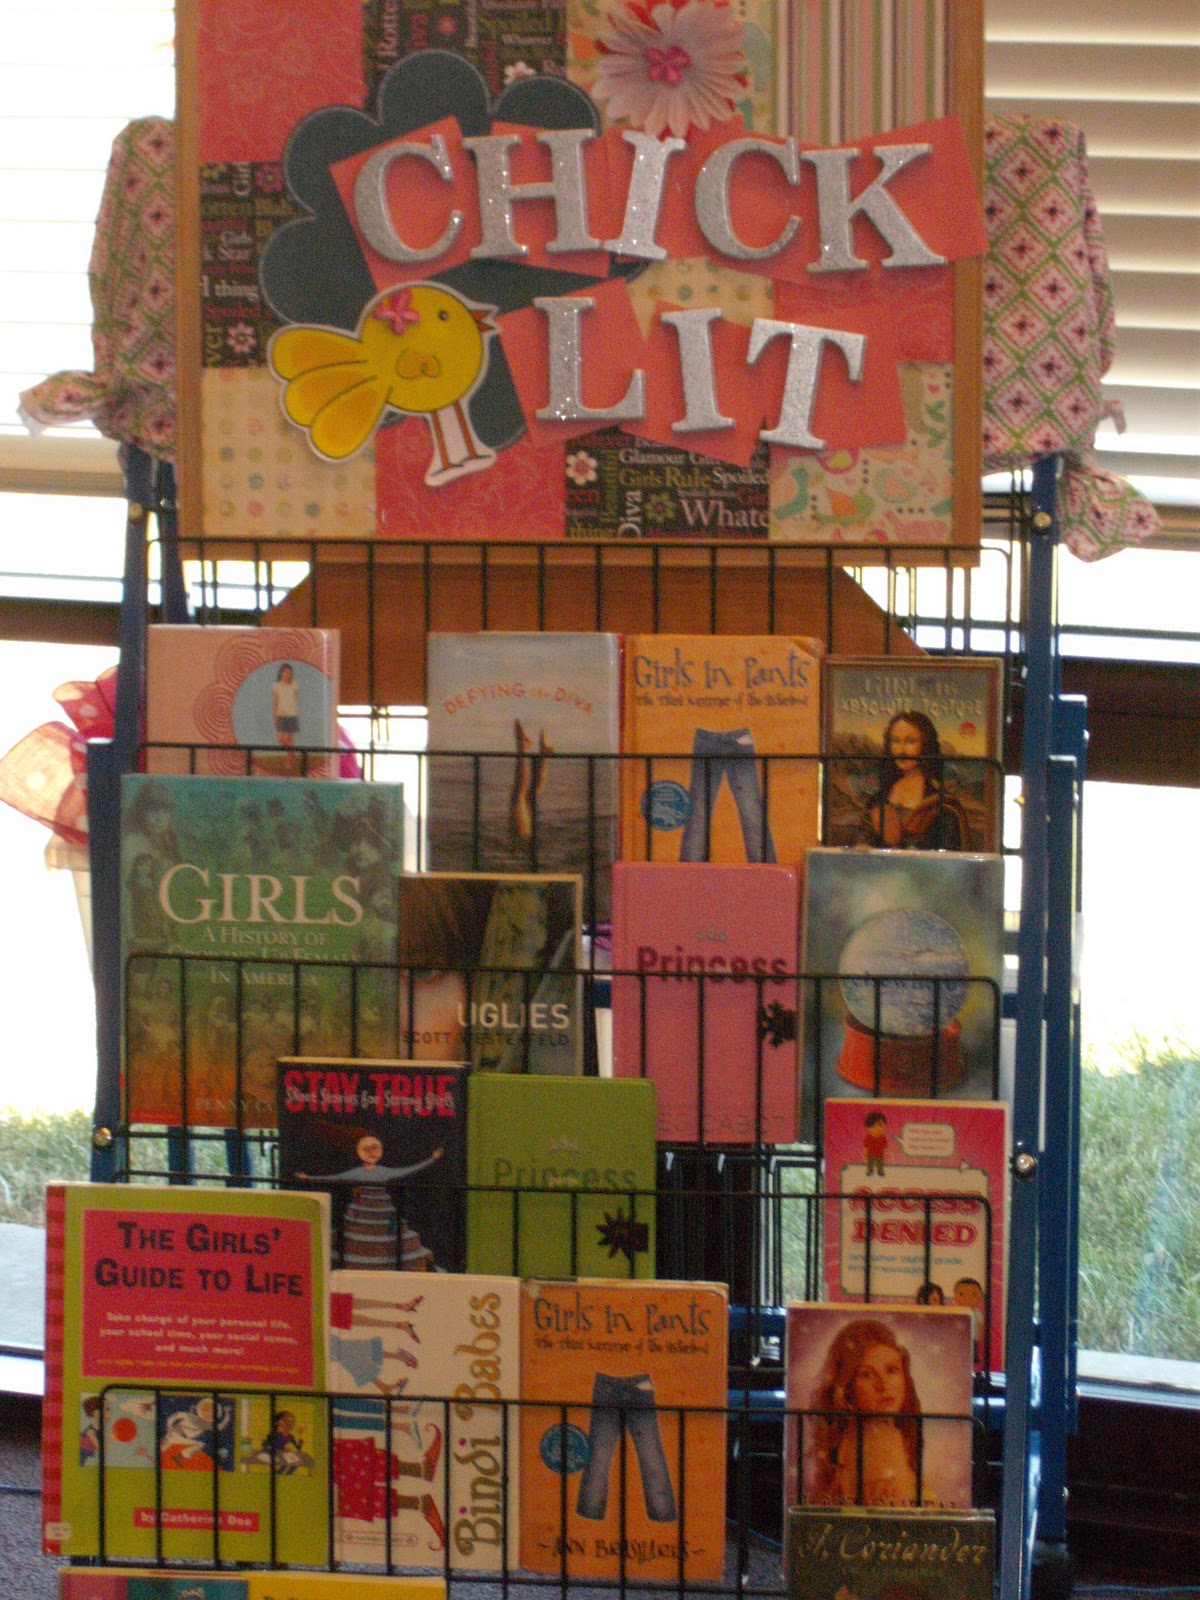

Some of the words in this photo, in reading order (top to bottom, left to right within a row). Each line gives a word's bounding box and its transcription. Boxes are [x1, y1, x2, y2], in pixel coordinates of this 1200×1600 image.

[352, 128, 947, 274] CHICK
[533, 296, 866, 449] LIT
[633, 647, 694, 689] Girls
[744, 650, 811, 690] Pants
[443, 681, 526, 716] DEFYING
[159, 862, 364, 927] GIRLS
[200, 926, 215, 944] A
[220, 926, 298, 947] HISTORY
[304, 931, 328, 947] OF
[636, 945, 788, 985] Princess
[284, 1070, 359, 1114] STAY
[369, 1073, 456, 1118] TRUE
[118, 1221, 175, 1251] THE
[95, 1257, 184, 1290] GUIDE
[197, 1268, 232, 1292] TO
[245, 1264, 303, 1297] LIFE
[533, 1292, 594, 1334] Girls
[646, 1296, 712, 1336] Pants
[453, 1292, 501, 1421] Babes
[454, 1435, 503, 1557] Bindi
